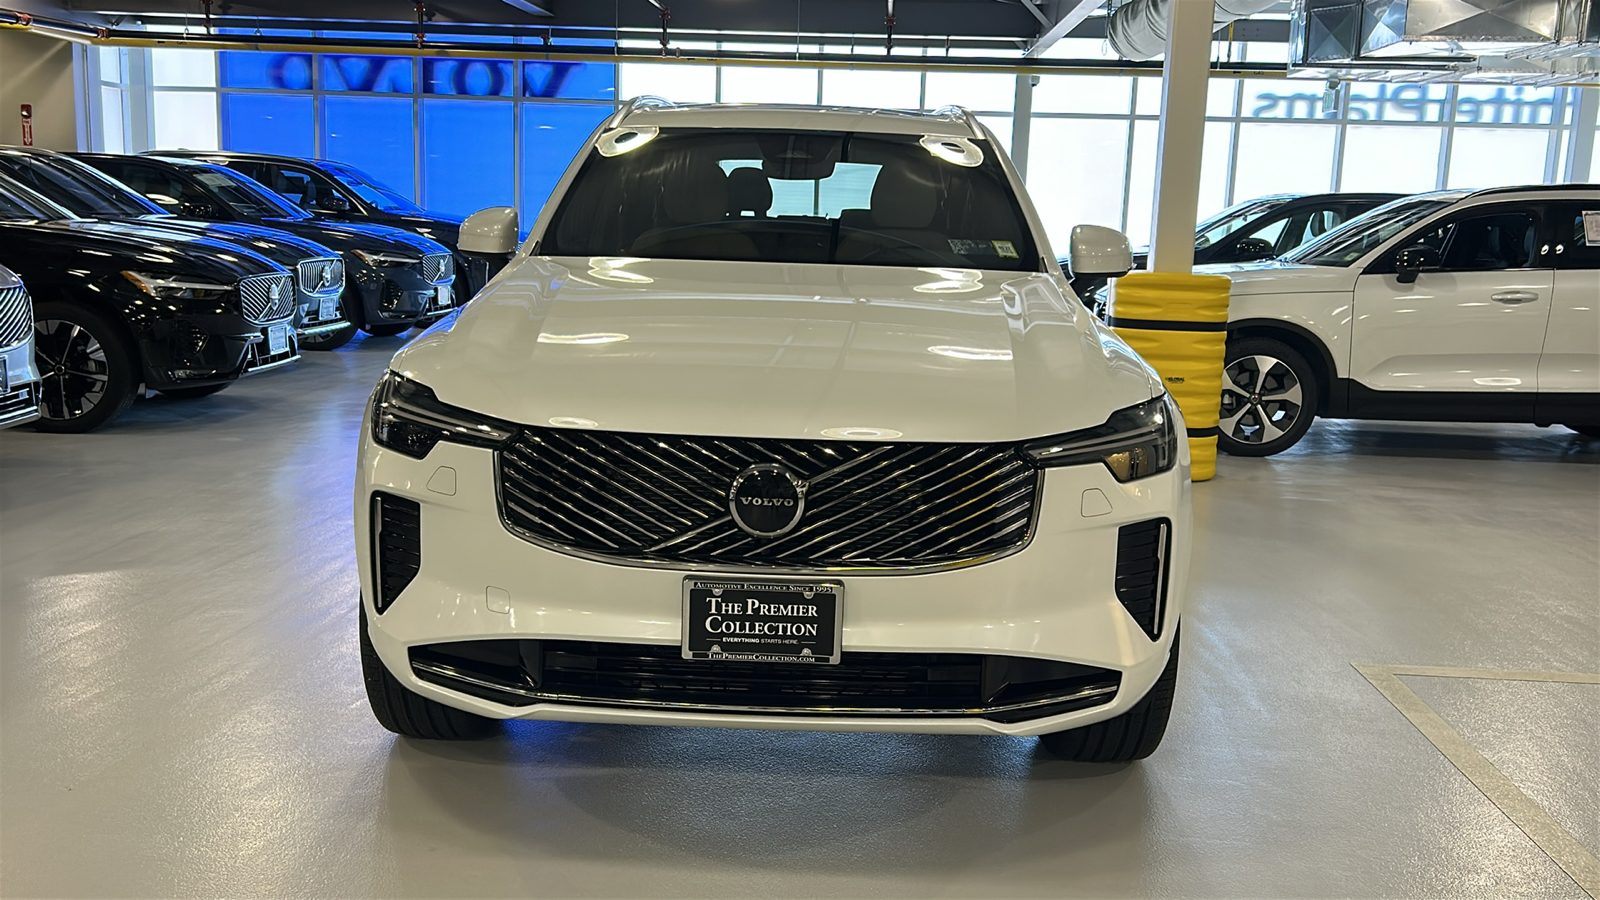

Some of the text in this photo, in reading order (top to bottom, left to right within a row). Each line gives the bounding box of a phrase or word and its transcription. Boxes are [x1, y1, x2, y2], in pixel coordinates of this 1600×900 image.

[739, 497, 794, 507] VOLVO
[695, 582, 743, 590] AUTOMOTIVE
[744, 583, 788, 591] EXCELLENCE
[812, 585, 832, 593] 1995
[705, 597, 818, 617] THE PREMIER
[705, 615, 818, 636] COLLECTION
